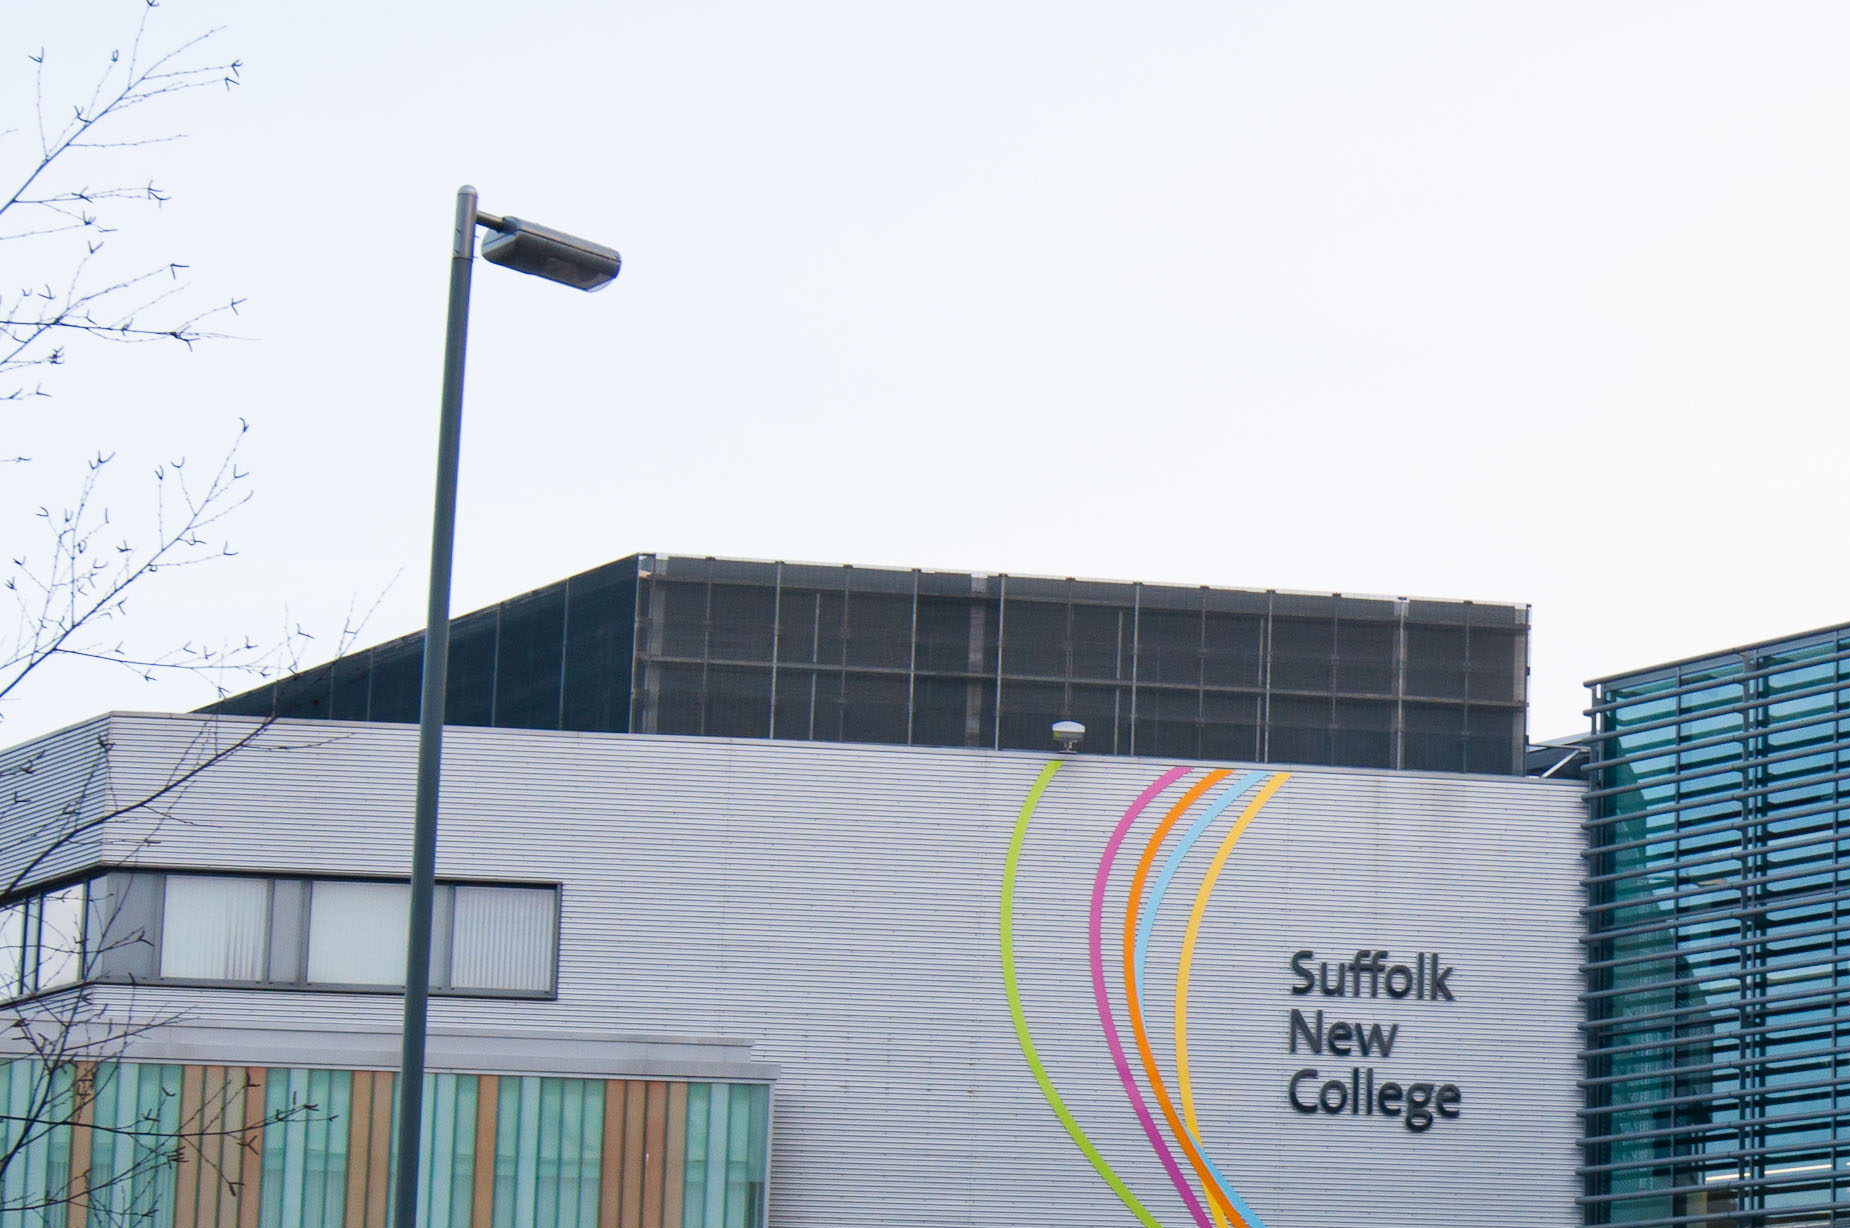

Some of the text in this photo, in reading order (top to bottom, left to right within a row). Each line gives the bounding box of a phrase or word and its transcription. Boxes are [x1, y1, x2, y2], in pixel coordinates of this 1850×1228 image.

[1290, 949, 1456, 1001] Suffolk
[1289, 1008, 1399, 1058] New
[1288, 1066, 1462, 1132] College
